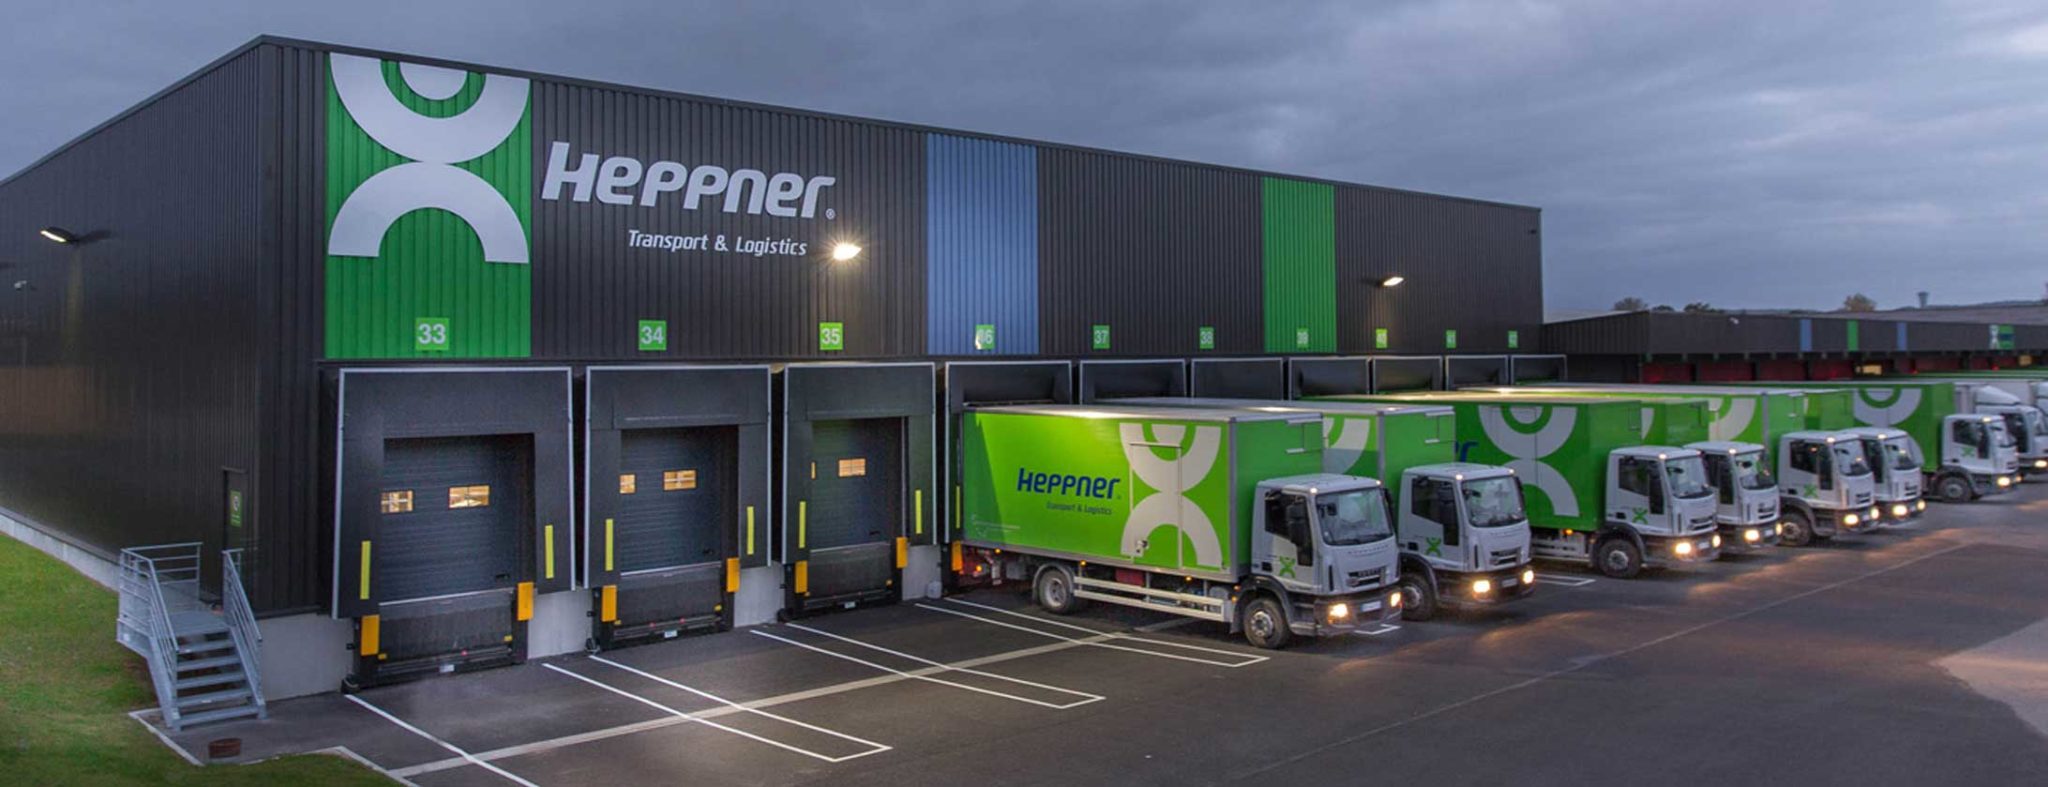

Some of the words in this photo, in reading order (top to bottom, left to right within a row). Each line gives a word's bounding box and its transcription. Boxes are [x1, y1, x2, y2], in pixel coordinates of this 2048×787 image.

[628, 229, 709, 252] Transport
[714, 234, 729, 251] &
[735, 236, 808, 257] Logistics
[417, 323, 446, 344] 33
[640, 325, 663, 345] 34
[821, 327, 841, 345] 35
[1094, 329, 1109, 345] 37
